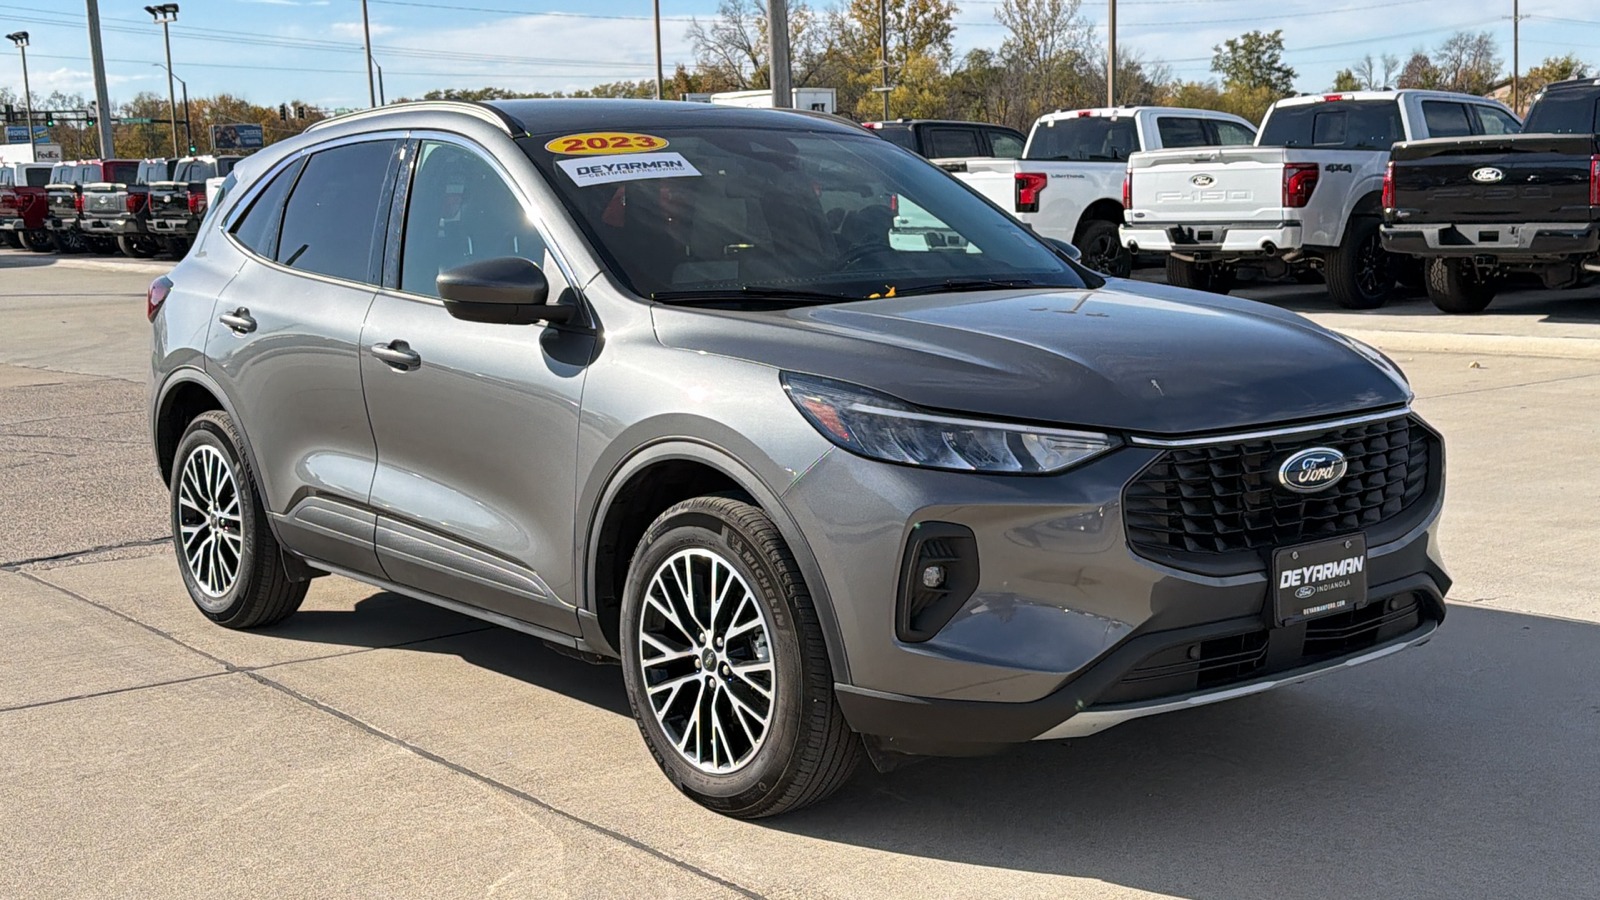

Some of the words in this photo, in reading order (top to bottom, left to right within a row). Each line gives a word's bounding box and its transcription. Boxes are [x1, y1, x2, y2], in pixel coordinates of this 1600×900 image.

[562, 136, 657, 151] 2023
[37, 151, 60, 159] FedEx
[576, 160, 682, 175] DEYARMAN
[589, 168, 633, 178] CERTIFIED
[1193, 174, 1214, 185] Ford
[1156, 190, 1253, 203] F-150
[1299, 456, 1335, 482] Ford
[1280, 556, 1364, 589] DEYARMAN
[742, 550, 785, 627] MICHELIN
[1316, 579, 1351, 593] INDIANOLA
[1303, 600, 1346, 615] DEYARMANFORD.COM
